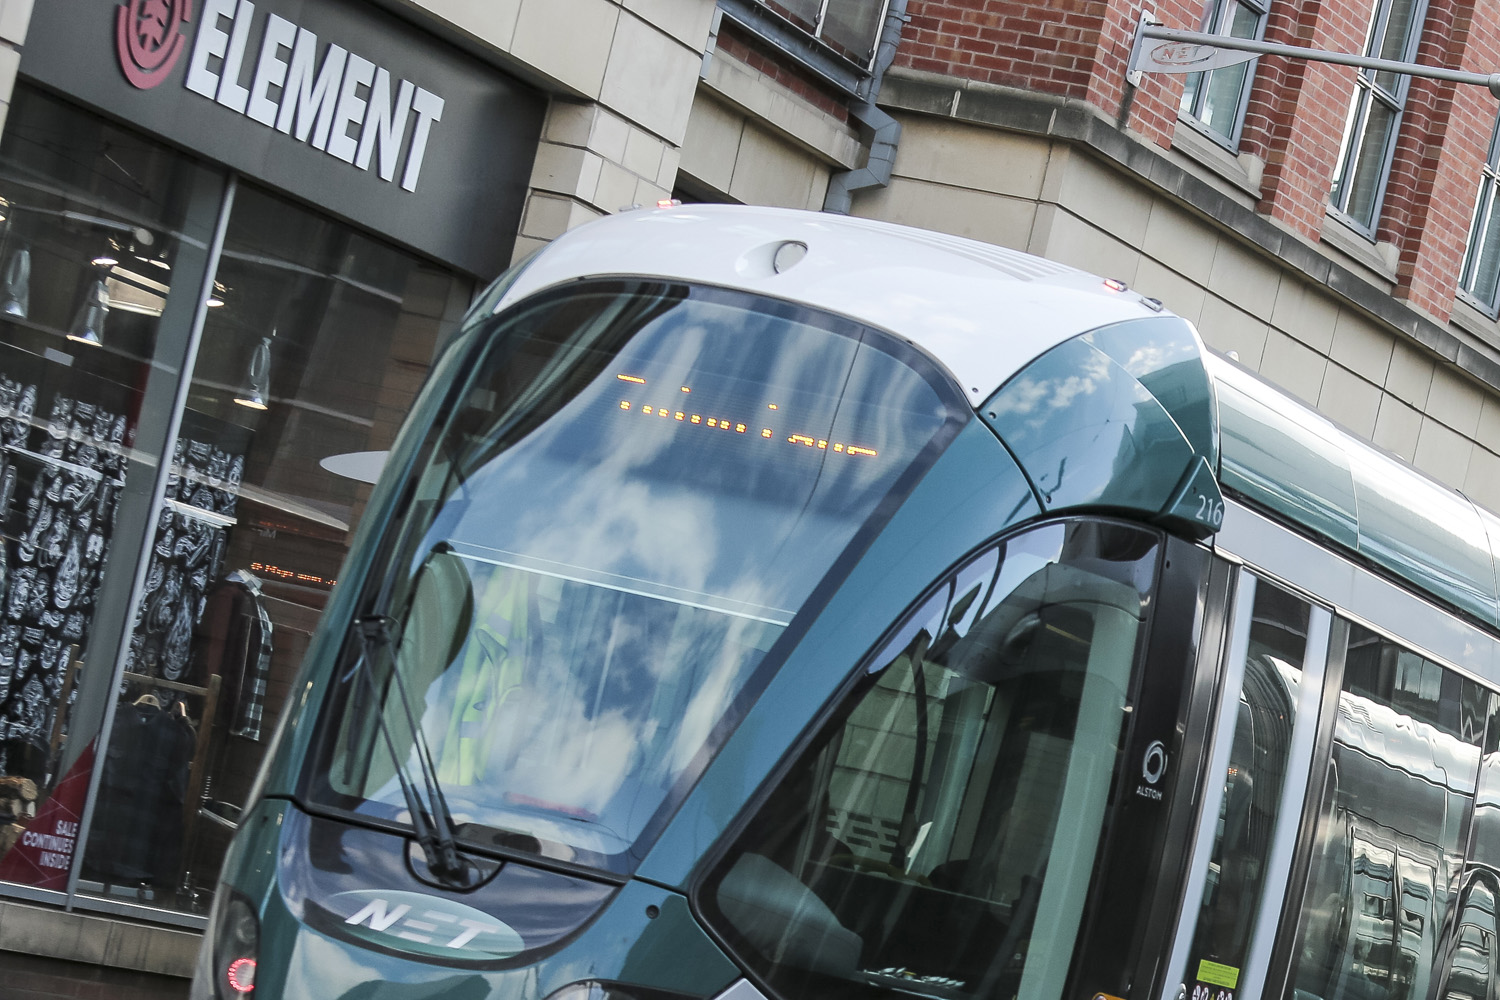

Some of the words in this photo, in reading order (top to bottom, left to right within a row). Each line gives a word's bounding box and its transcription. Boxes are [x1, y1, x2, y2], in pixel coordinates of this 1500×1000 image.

[184, 0, 445, 193] ELEMENT
[1195, 494, 1223, 526] 216
[1136, 785, 1163, 801] ALSTOM
[56, 819, 78, 838] SALE
[22, 830, 75, 854] CONTINUES
[39, 851, 71, 871] INSIDE
[345, 898, 499, 950] NET
